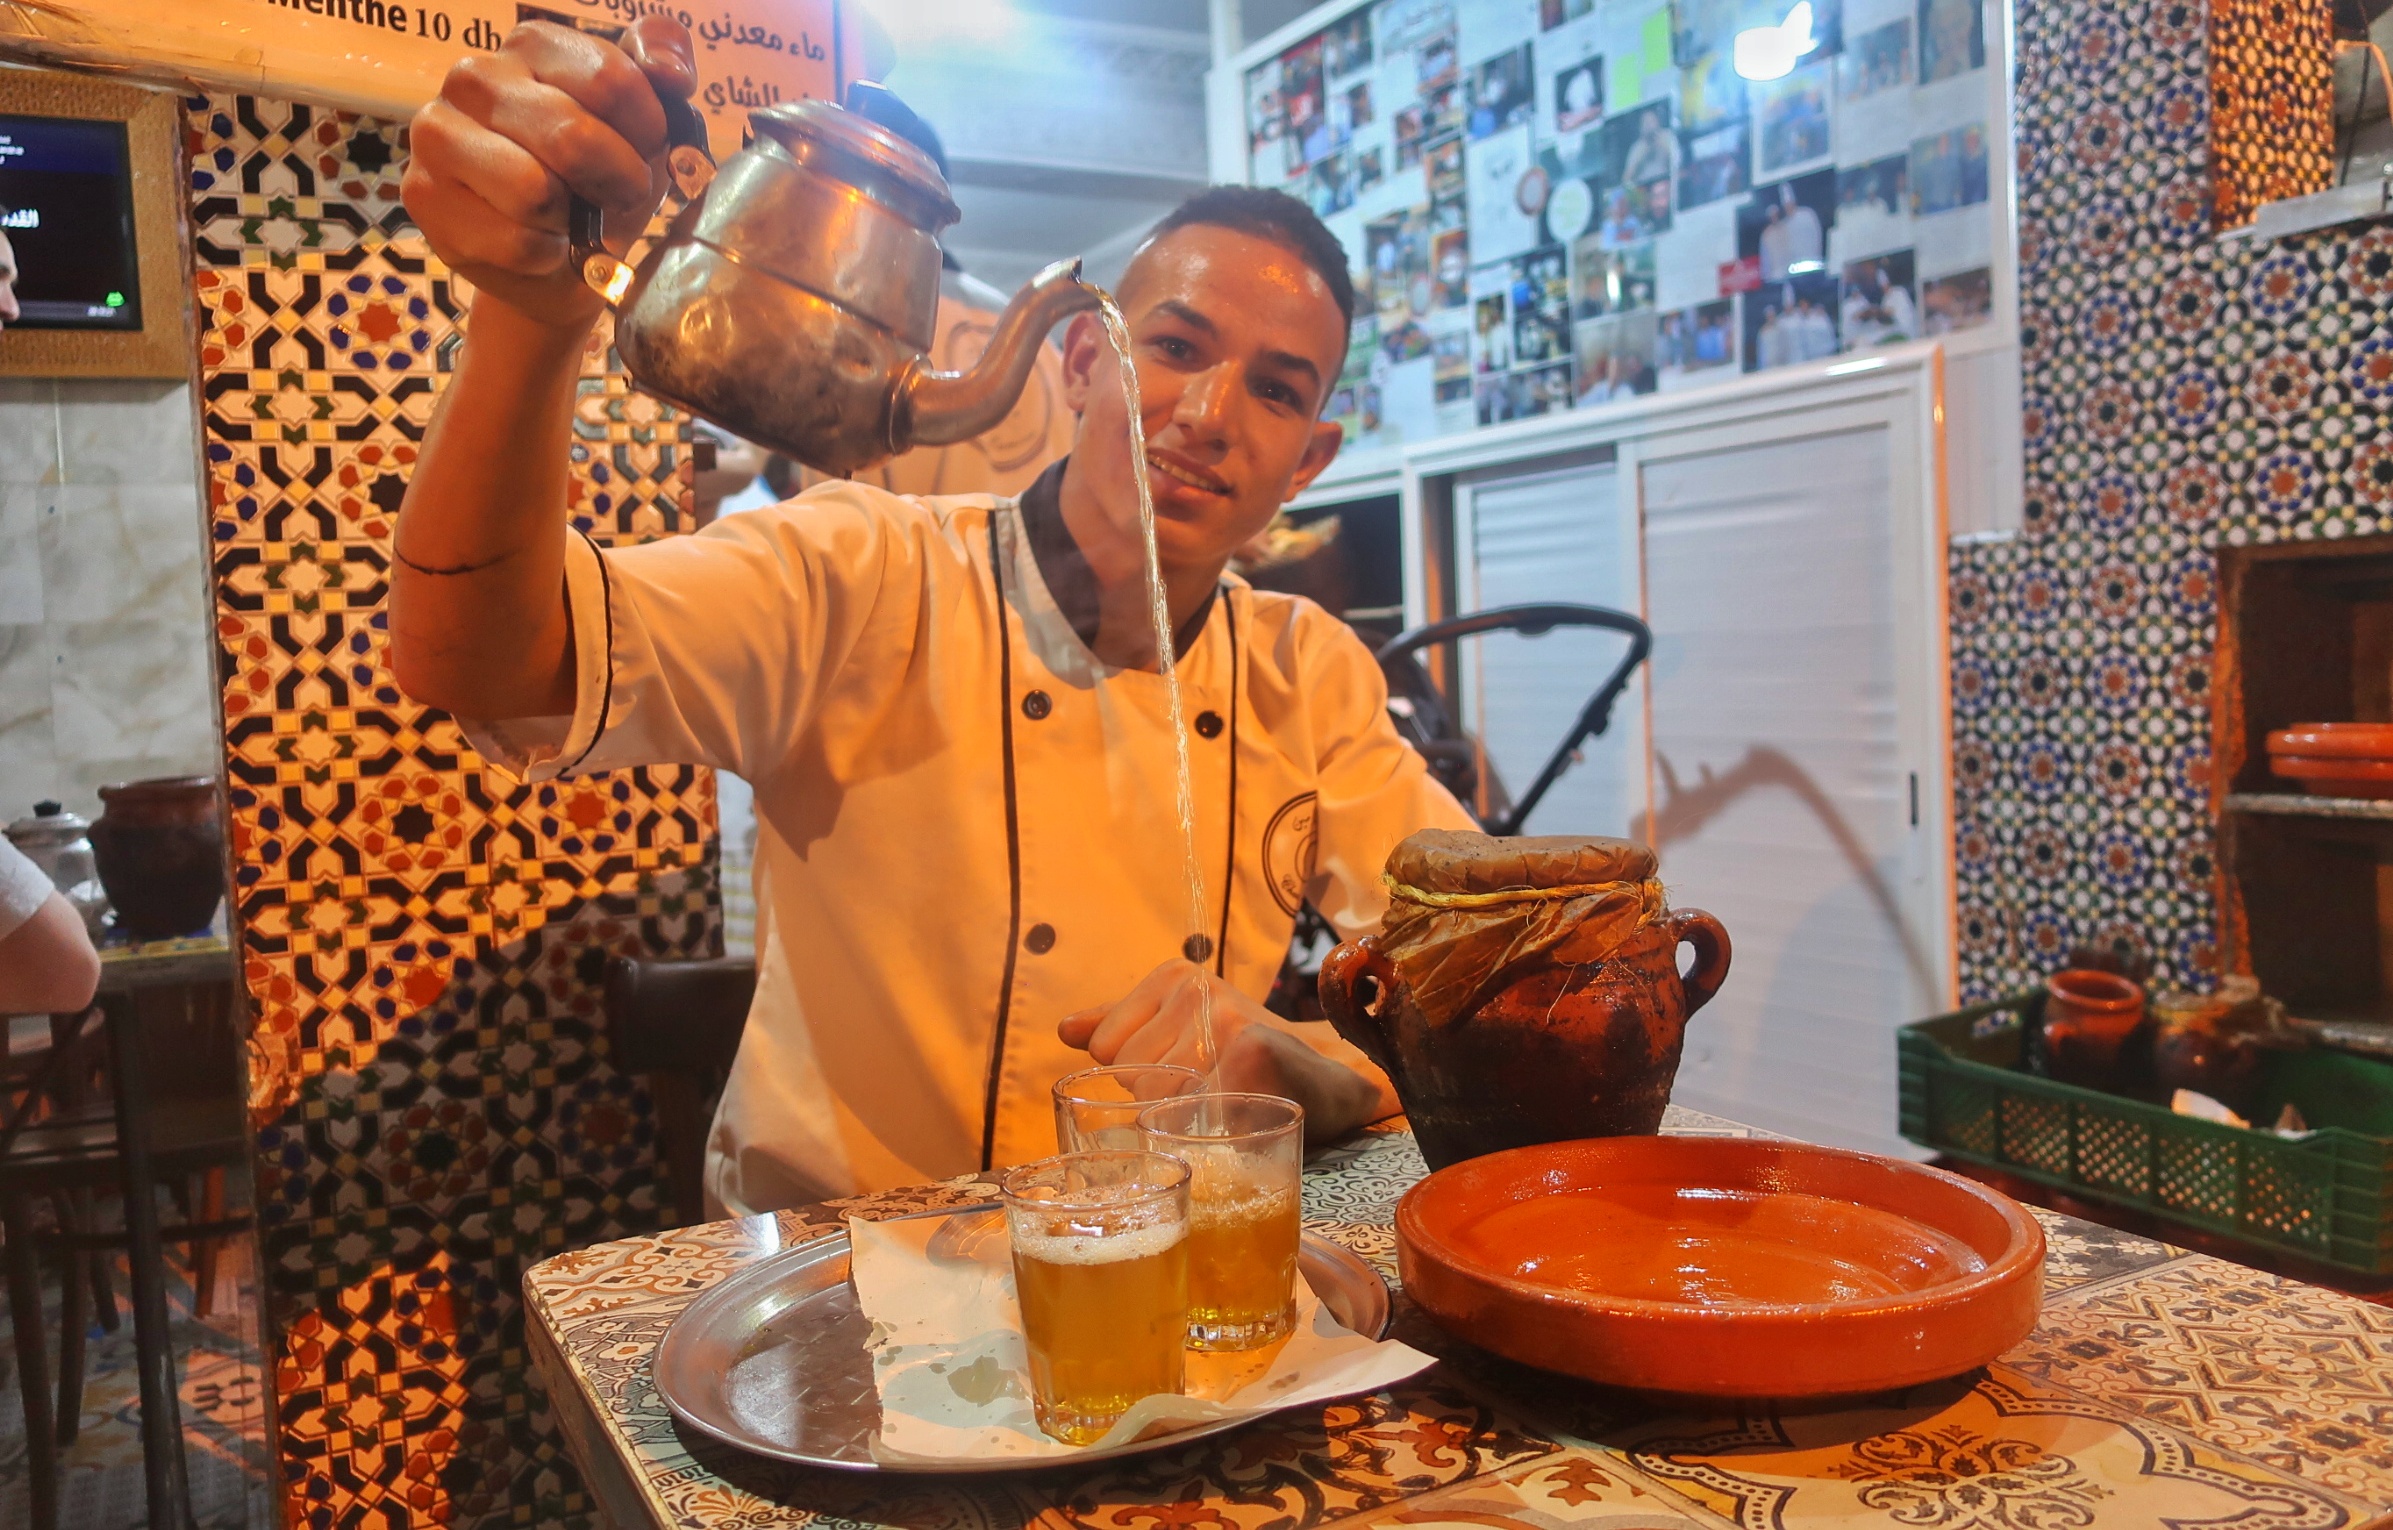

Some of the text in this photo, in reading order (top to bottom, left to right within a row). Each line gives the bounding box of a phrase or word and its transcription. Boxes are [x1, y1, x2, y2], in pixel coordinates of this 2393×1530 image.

[415, 8, 451, 42] 10
[699, 12, 784, 51] معدني
[788, 31, 826, 61] ماء
[702, 74, 781, 115] الشاي
